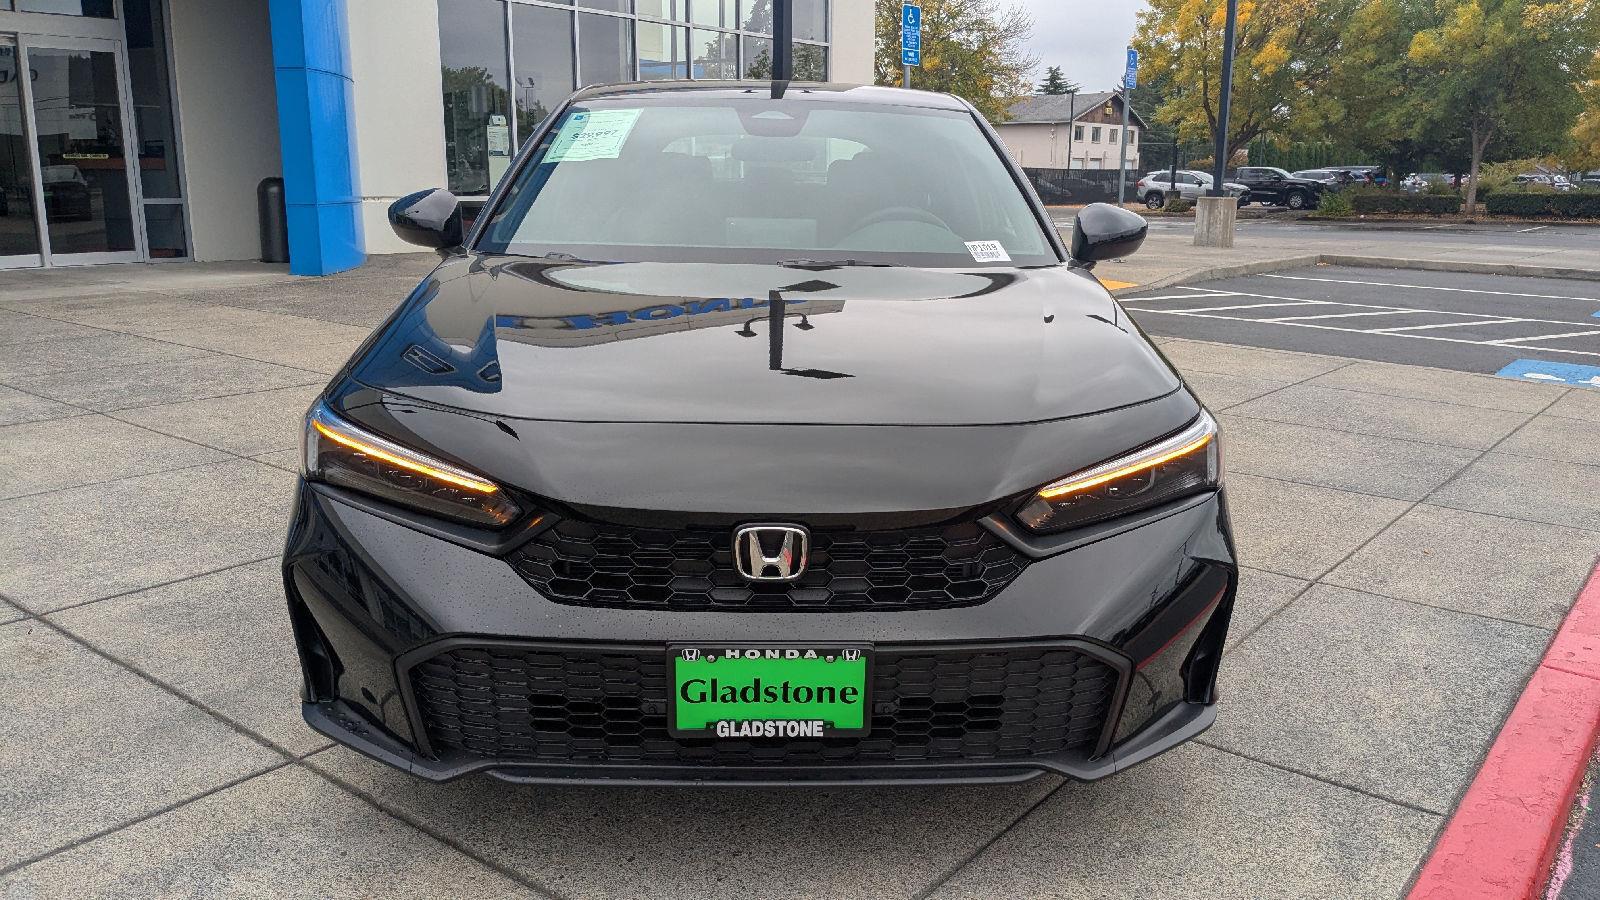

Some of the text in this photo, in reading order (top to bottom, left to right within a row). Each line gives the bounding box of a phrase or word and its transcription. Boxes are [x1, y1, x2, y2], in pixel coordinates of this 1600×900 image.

[725, 649, 818, 659] HONDA
[680, 677, 859, 704] Gladstone
[716, 720, 824, 738] GLADSTONE
